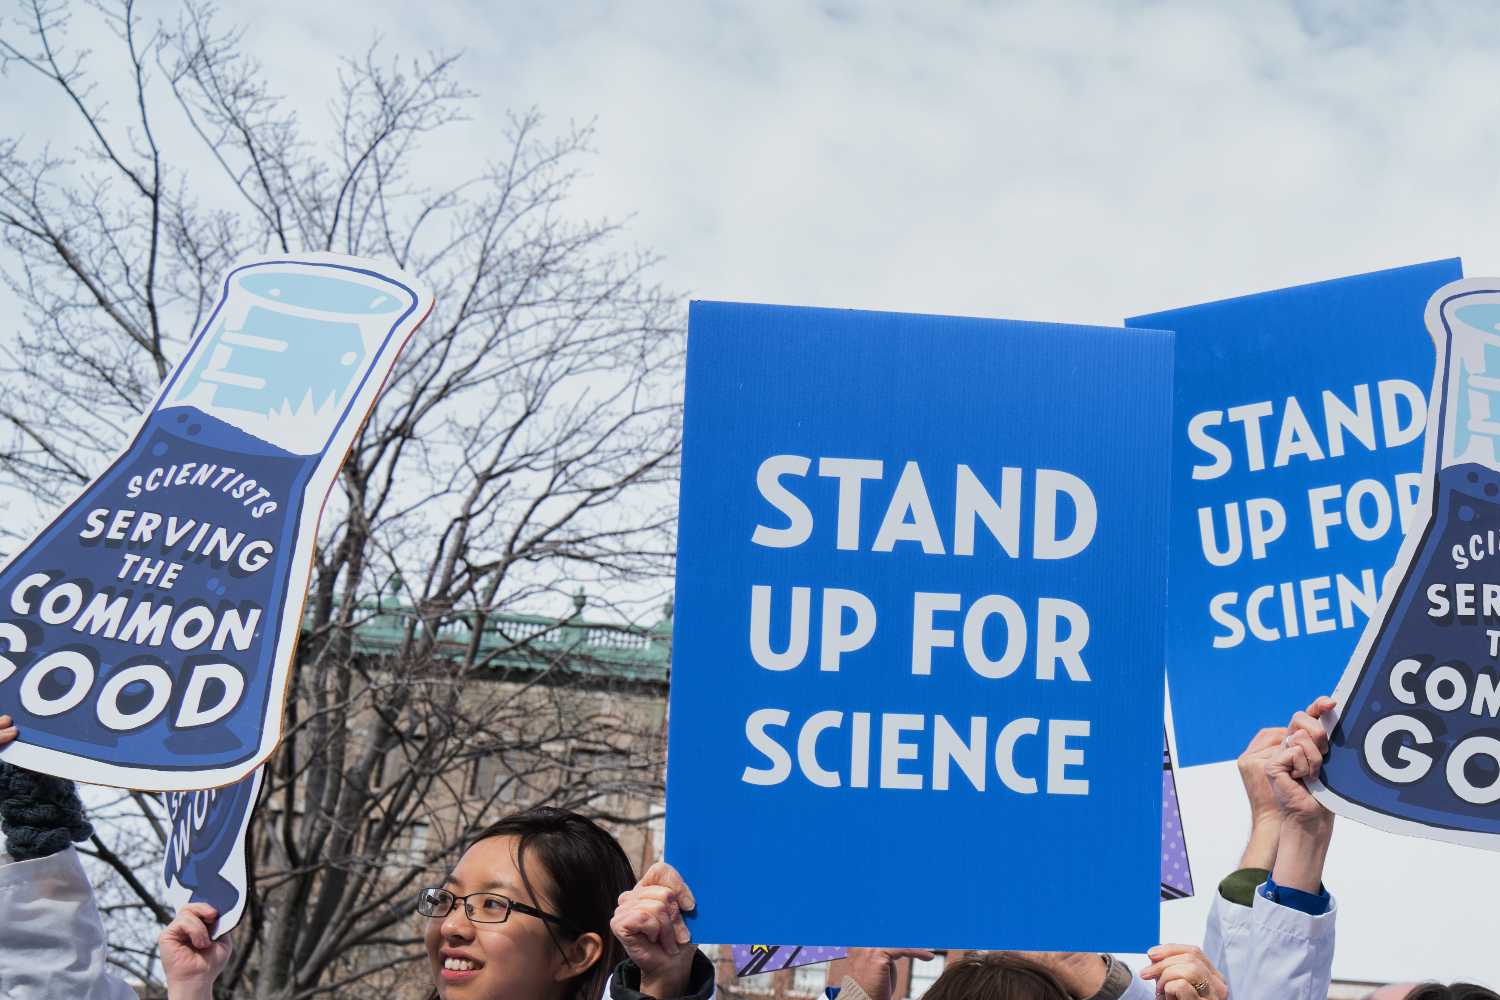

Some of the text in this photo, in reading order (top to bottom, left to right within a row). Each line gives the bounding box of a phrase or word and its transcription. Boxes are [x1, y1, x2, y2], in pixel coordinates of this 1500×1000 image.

[1187, 379, 1427, 481] STAND
[127, 462, 277, 519] SCIENTISTS
[750, 454, 1098, 560] STAND
[79, 509, 274, 572] SERVING
[1198, 496, 1287, 566] UP
[117, 553, 183, 589] THE
[1209, 568, 1395, 649] SCIEN
[11, 573, 262, 651] COMMON
[749, 585, 1092, 682] UP FOR
[741, 708, 1091, 795] SCIENCE
